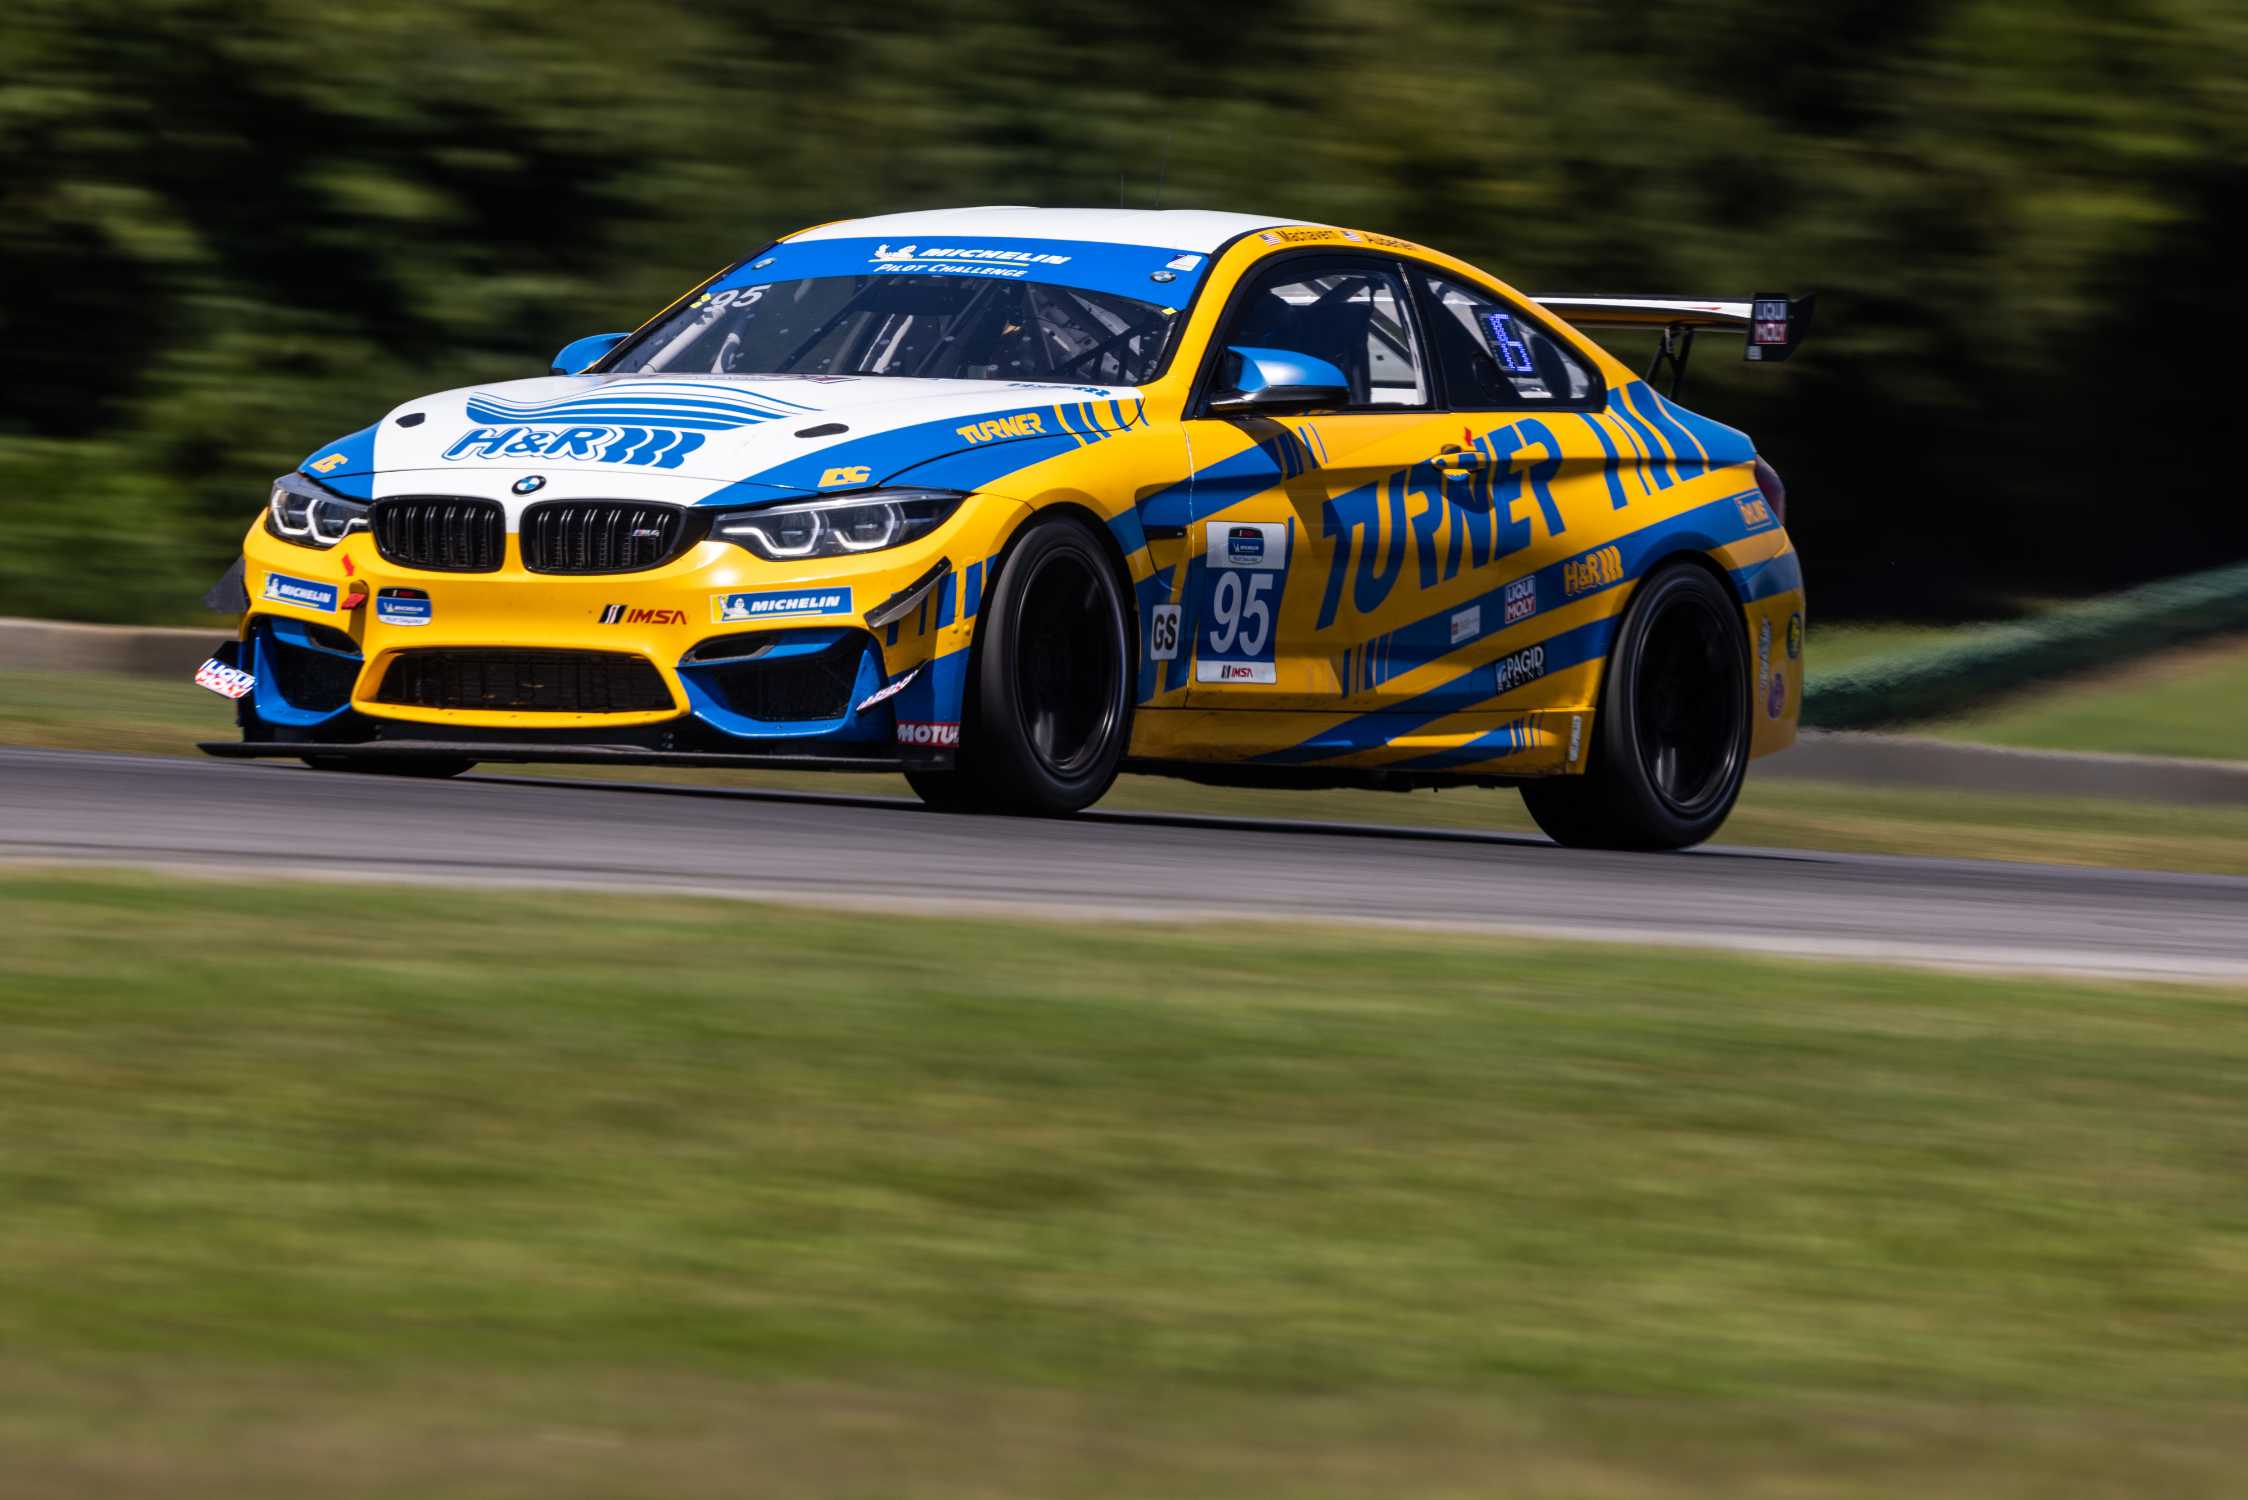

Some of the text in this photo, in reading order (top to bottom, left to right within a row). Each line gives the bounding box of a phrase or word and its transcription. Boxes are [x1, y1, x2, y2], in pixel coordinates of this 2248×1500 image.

[918, 248, 1072, 265] MICHELIN
[873, 263, 1028, 278] PILOT CHALLENGE
[703, 284, 772, 313] 95
[956, 412, 1047, 445] TURNER
[441, 426, 625, 462] H&R
[1315, 417, 1567, 632] TURNER
[1563, 549, 1608, 597] H&R
[279, 583, 332, 604] MICHELIN
[1506, 578, 1536, 602] LIQUI
[750, 595, 841, 612] MICHELIN
[1209, 570, 1275, 657] 95
[1506, 596, 1536, 620] MOLY
[626, 608, 688, 626] IMSA
[1152, 613, 1178, 651] GS
[1231, 667, 1254, 679] IMSA
[1506, 646, 1545, 680] PAGID
